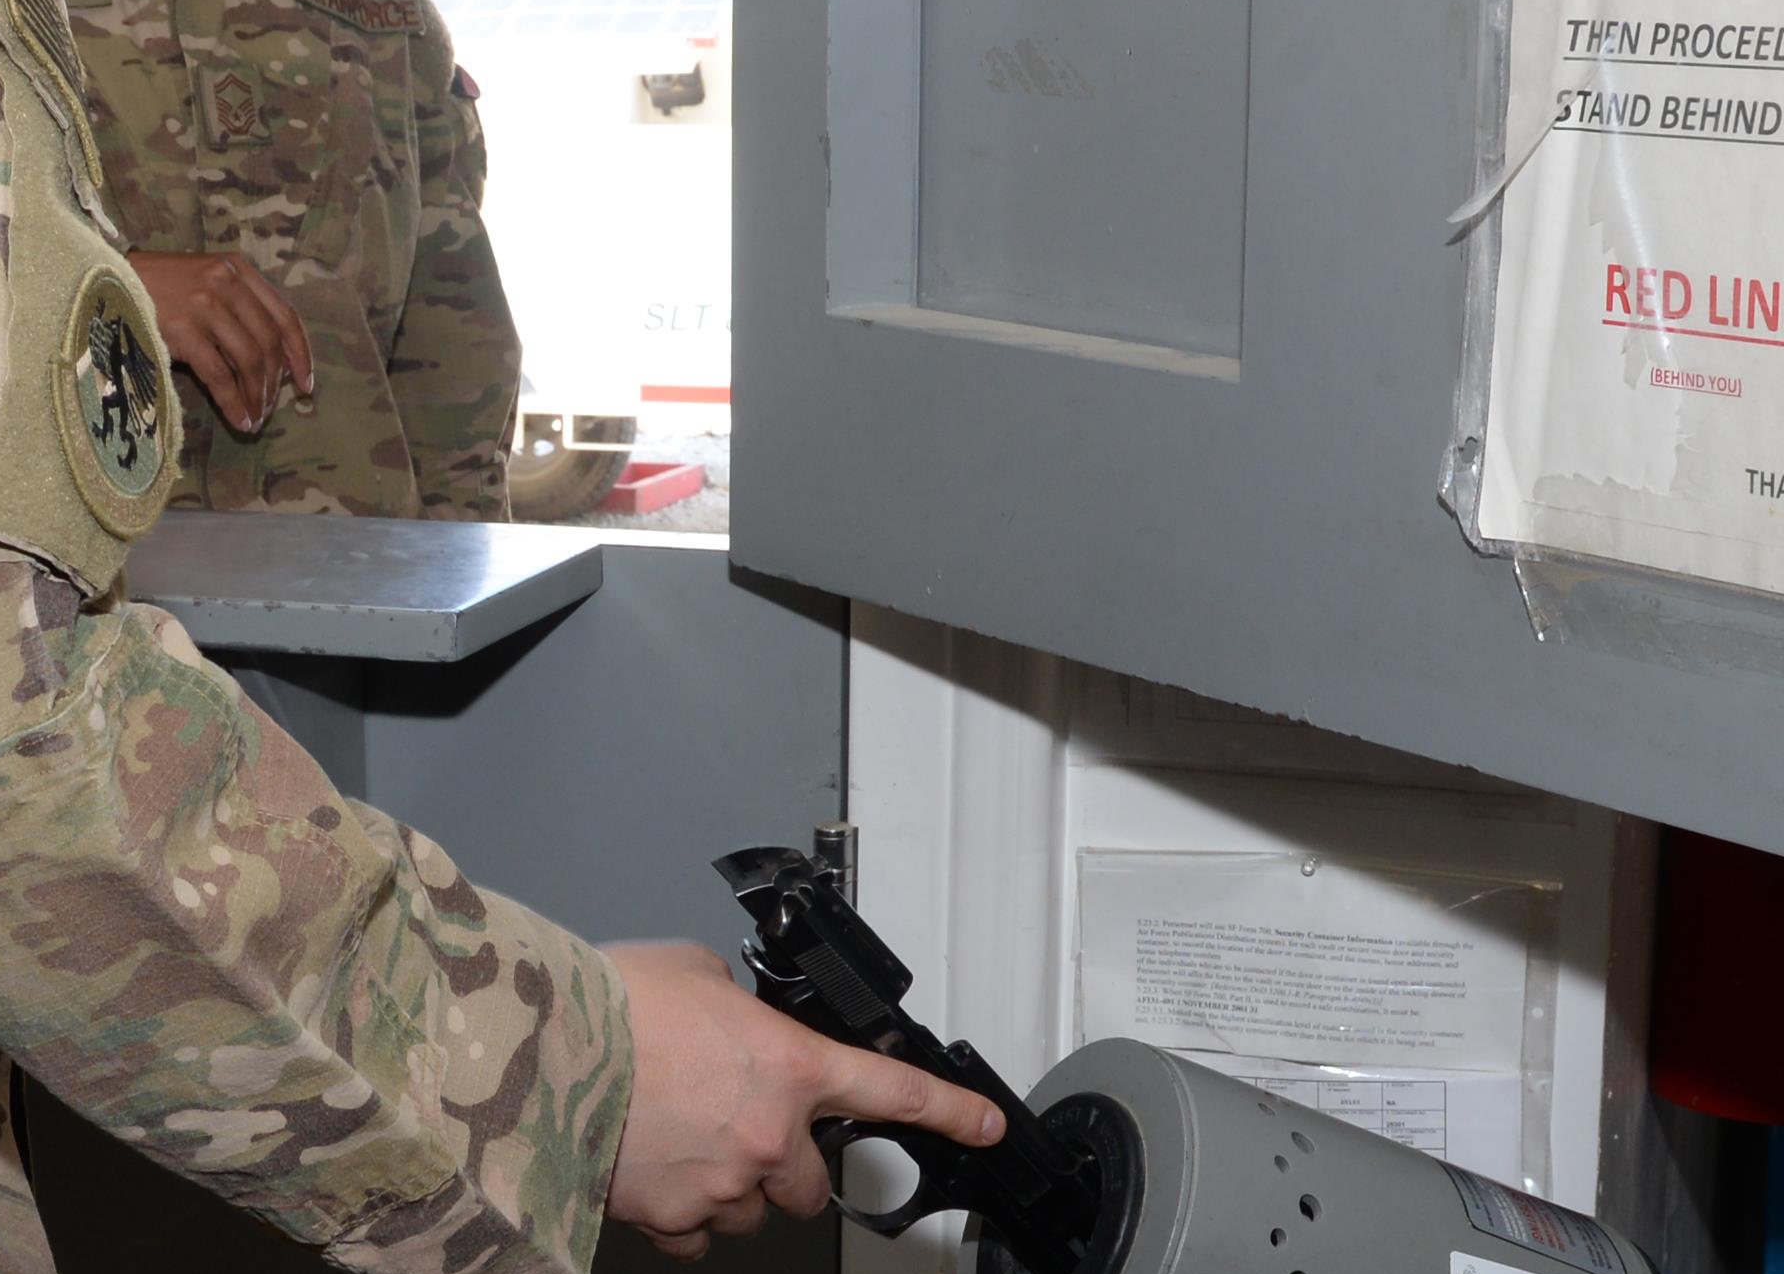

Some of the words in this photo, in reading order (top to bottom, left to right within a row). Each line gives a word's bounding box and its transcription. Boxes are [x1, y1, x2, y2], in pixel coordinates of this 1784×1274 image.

[1564, 21, 1641, 60] THEN
[1552, 91, 1650, 133] STAND
[1661, 97, 1781, 135] BEHIND
[1607, 264, 1693, 319] RED
[644, 303, 713, 331] SLT
[1650, 367, 1705, 391] (BEHIND
[1708, 374, 1743, 397] YOU)
[1275, 929, 1304, 940] Security
[1306, 931, 1344, 942] Container
[1346, 935, 1392, 945] Information
